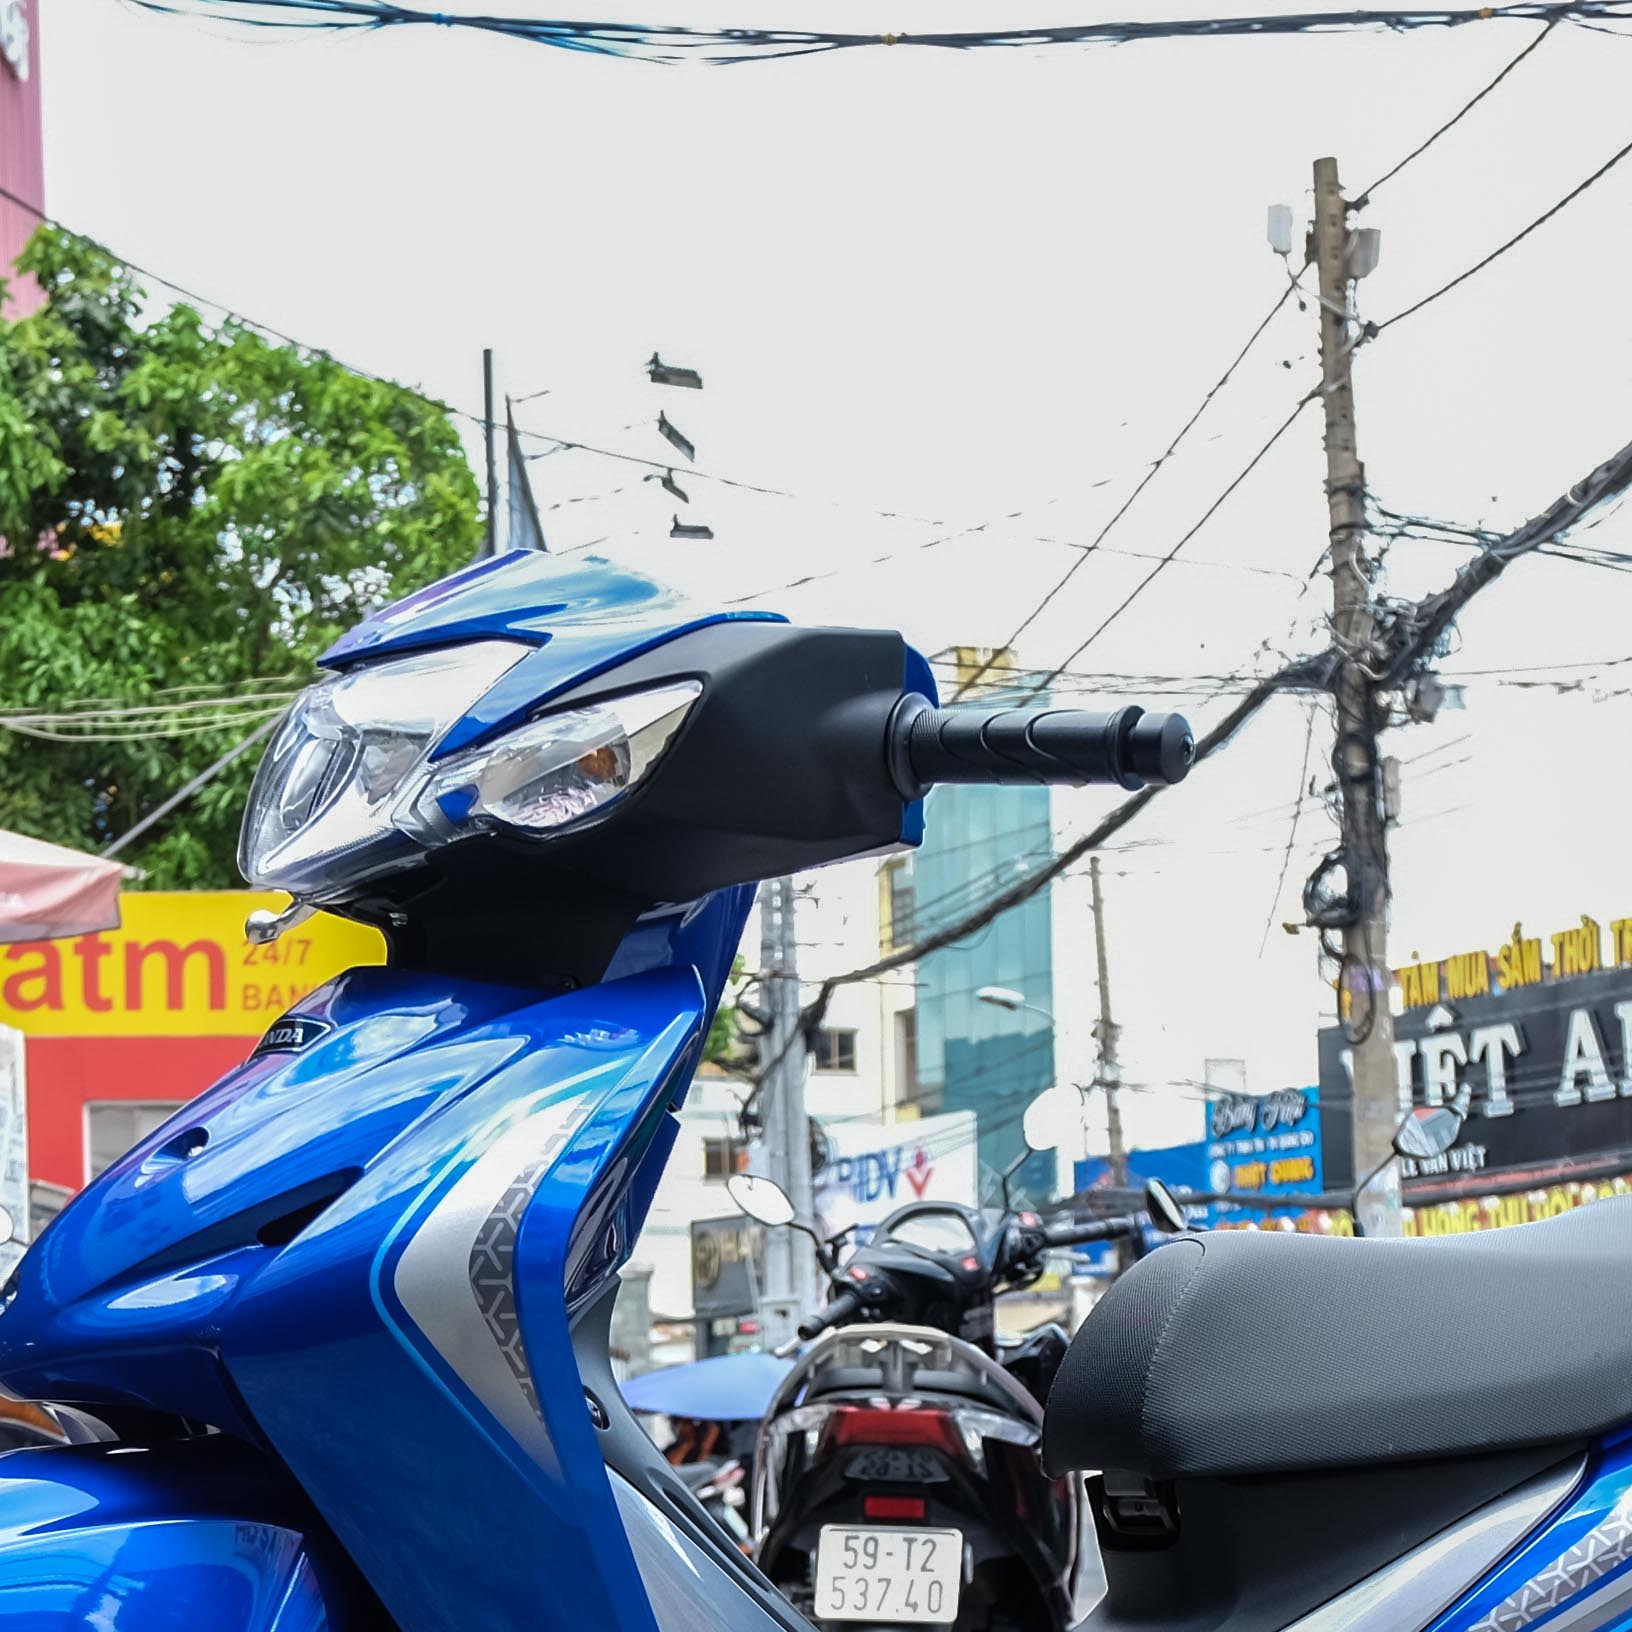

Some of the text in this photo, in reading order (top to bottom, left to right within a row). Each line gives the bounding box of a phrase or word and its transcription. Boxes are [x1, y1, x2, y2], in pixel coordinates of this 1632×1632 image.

[2, 928, 312, 1012] atm 24/7
[1446, 951, 1489, 999] MUA
[842, 1534, 939, 1574] 59-T2
[830, 1575, 944, 1614] 537.40
